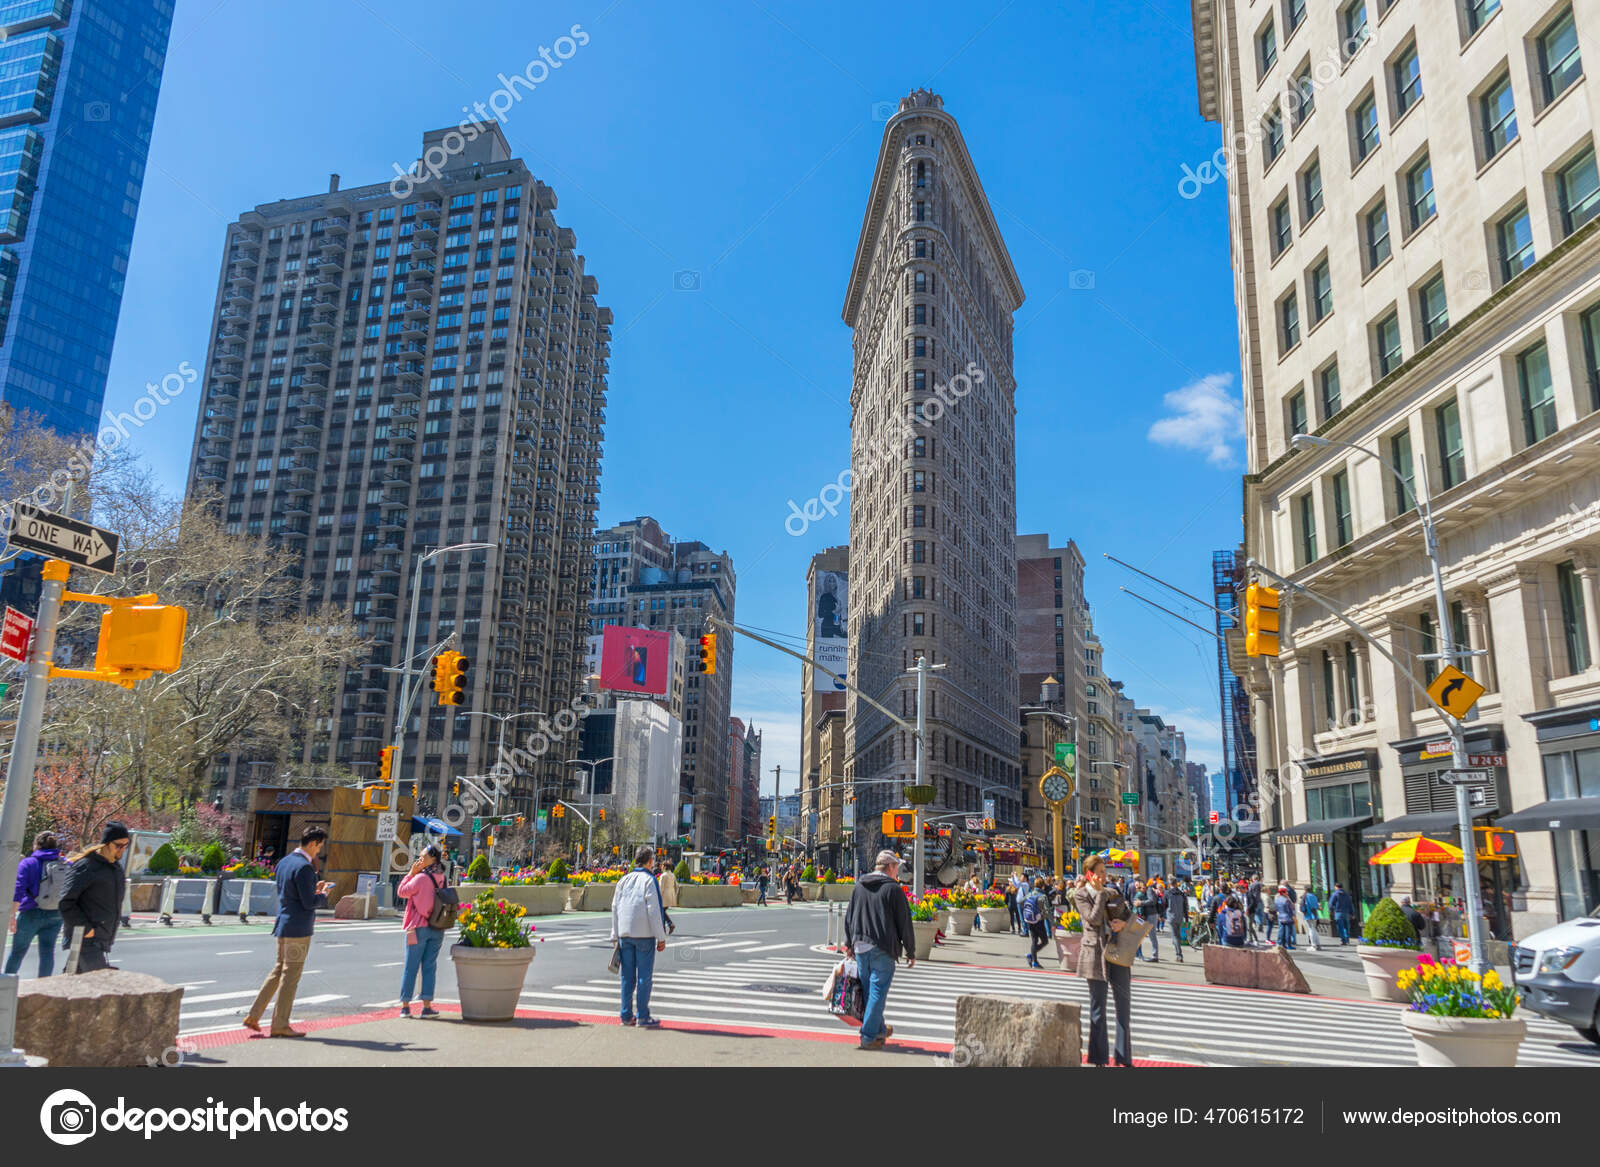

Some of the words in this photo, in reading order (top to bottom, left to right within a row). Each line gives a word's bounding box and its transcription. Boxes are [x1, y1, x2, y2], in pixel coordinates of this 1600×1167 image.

[27, 521, 59, 544] ONE
[73, 534, 103, 556] WAY
[819, 645, 848, 653] runnin
[1345, 760, 1362, 770] FOOD
[1470, 756, 1479, 765] W
[1481, 756, 1492, 765] 24
[1276, 834, 1300, 845] EATALY
